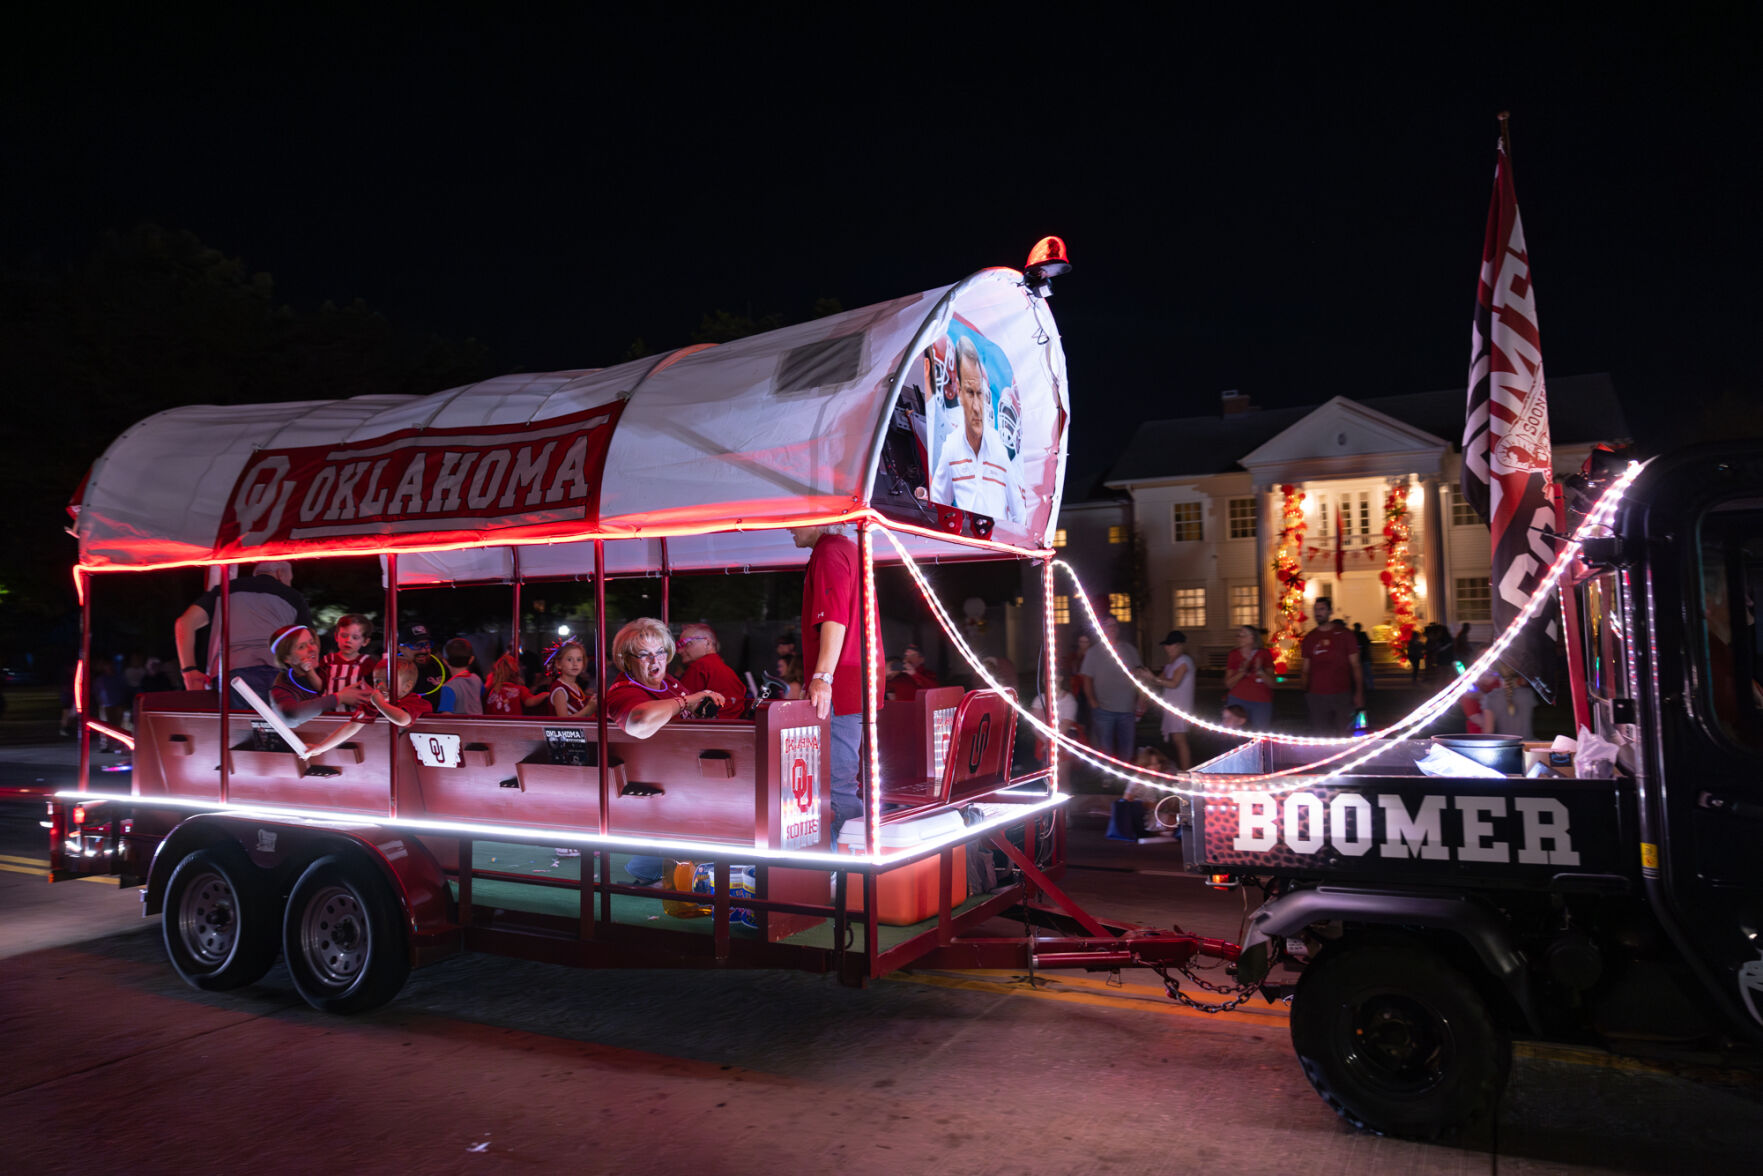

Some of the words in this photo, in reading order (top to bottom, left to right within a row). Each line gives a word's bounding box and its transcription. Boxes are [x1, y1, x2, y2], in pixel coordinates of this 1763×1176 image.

[234, 455, 297, 546] OU
[301, 435, 589, 522] OKLAHOMA
[429, 737, 445, 763] OU
[545, 730, 581, 738] OKLAHOMA
[792, 758, 813, 813] OU
[1231, 790, 1581, 866] BOOMER
